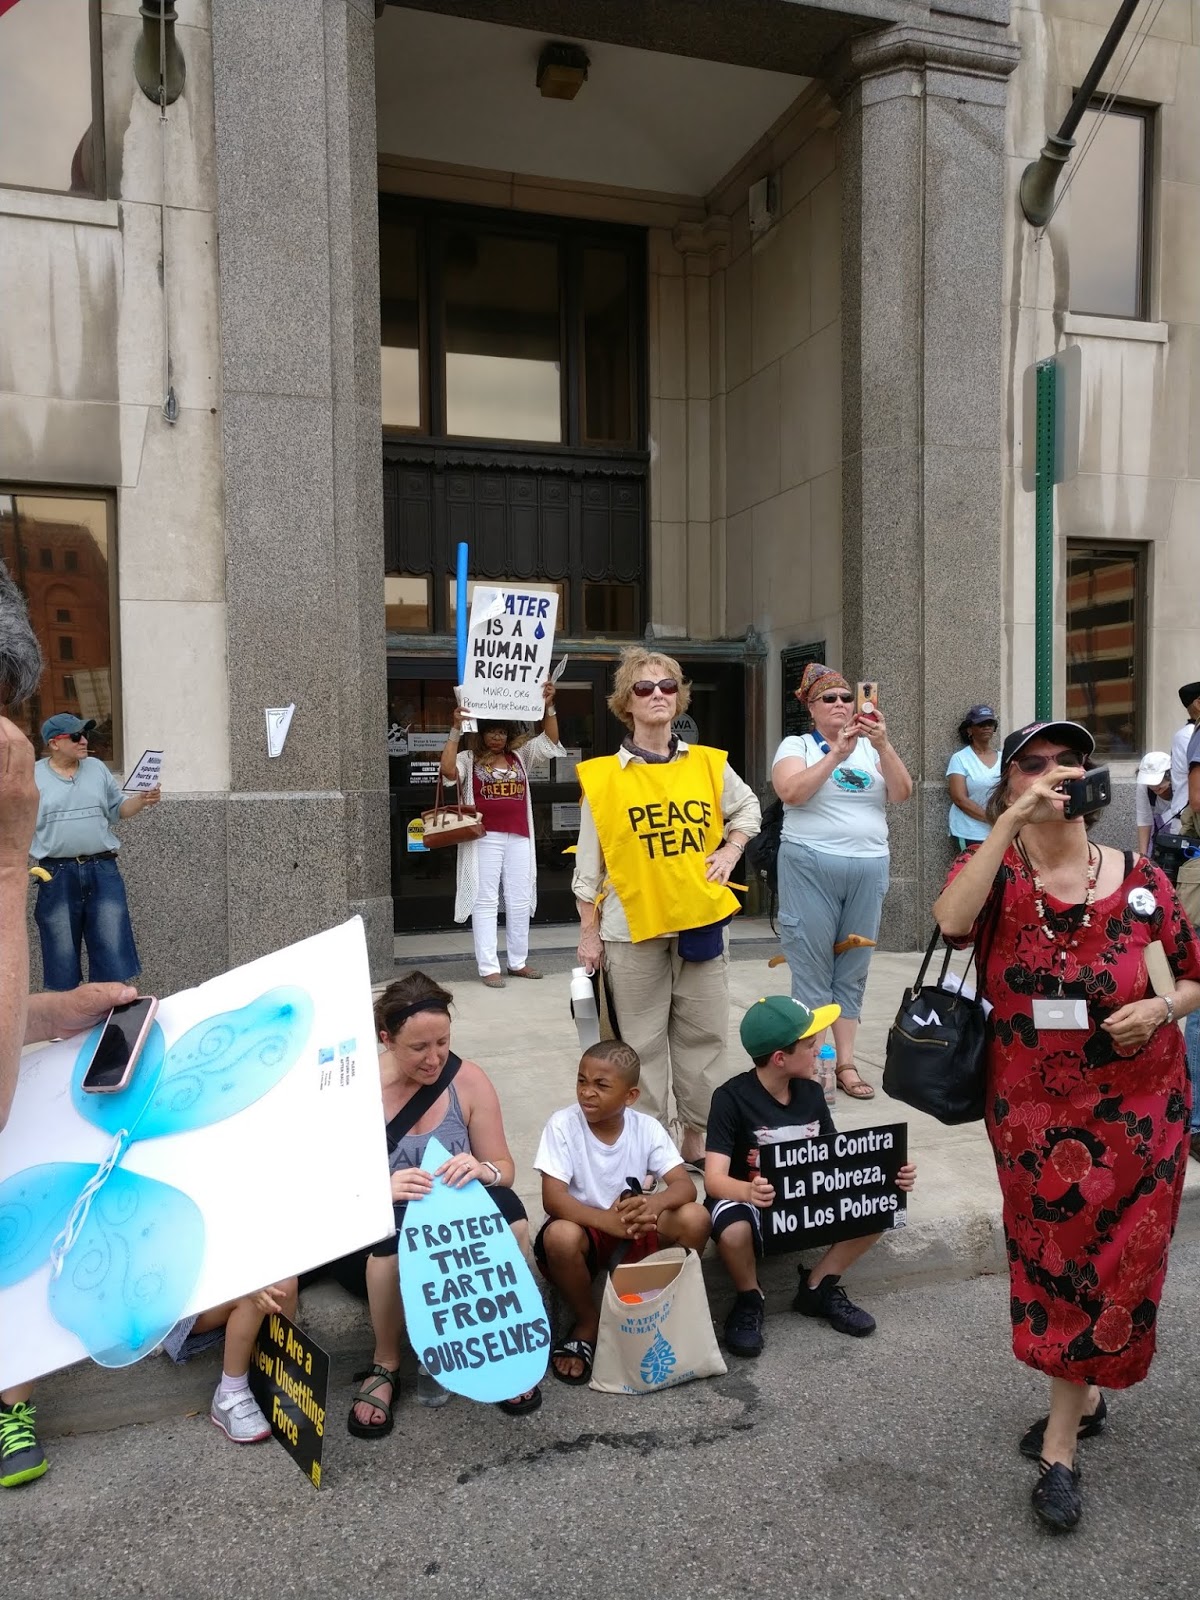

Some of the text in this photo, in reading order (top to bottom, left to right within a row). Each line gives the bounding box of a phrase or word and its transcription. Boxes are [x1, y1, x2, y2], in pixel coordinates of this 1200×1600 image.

[502, 593, 551, 618] ATER
[486, 619, 523, 637] IS A
[473, 638, 538, 663] HUMAN
[474, 660, 544, 684] RIGHT!
[628, 800, 711, 832] PEACE
[774, 1130, 893, 1168] Lucha Contra
[784, 1165, 886, 1200] La Pobreza,
[405, 1212, 506, 1252] PROTECT
[772, 1210, 798, 1235] No
[803, 1206, 835, 1229] Los
[840, 1193, 898, 1221] Pobres
[429, 1241, 491, 1275] THE
[422, 1261, 518, 1306] EARTH
[431, 1290, 523, 1336] FROM
[626, 1311, 660, 1326] WATER
[269, 1313, 313, 1376] We Are a
[422, 1317, 551, 1376] OURSELVES
[275, 1356, 326, 1438] Unsettling
[272, 1394, 299, 1447] Force
